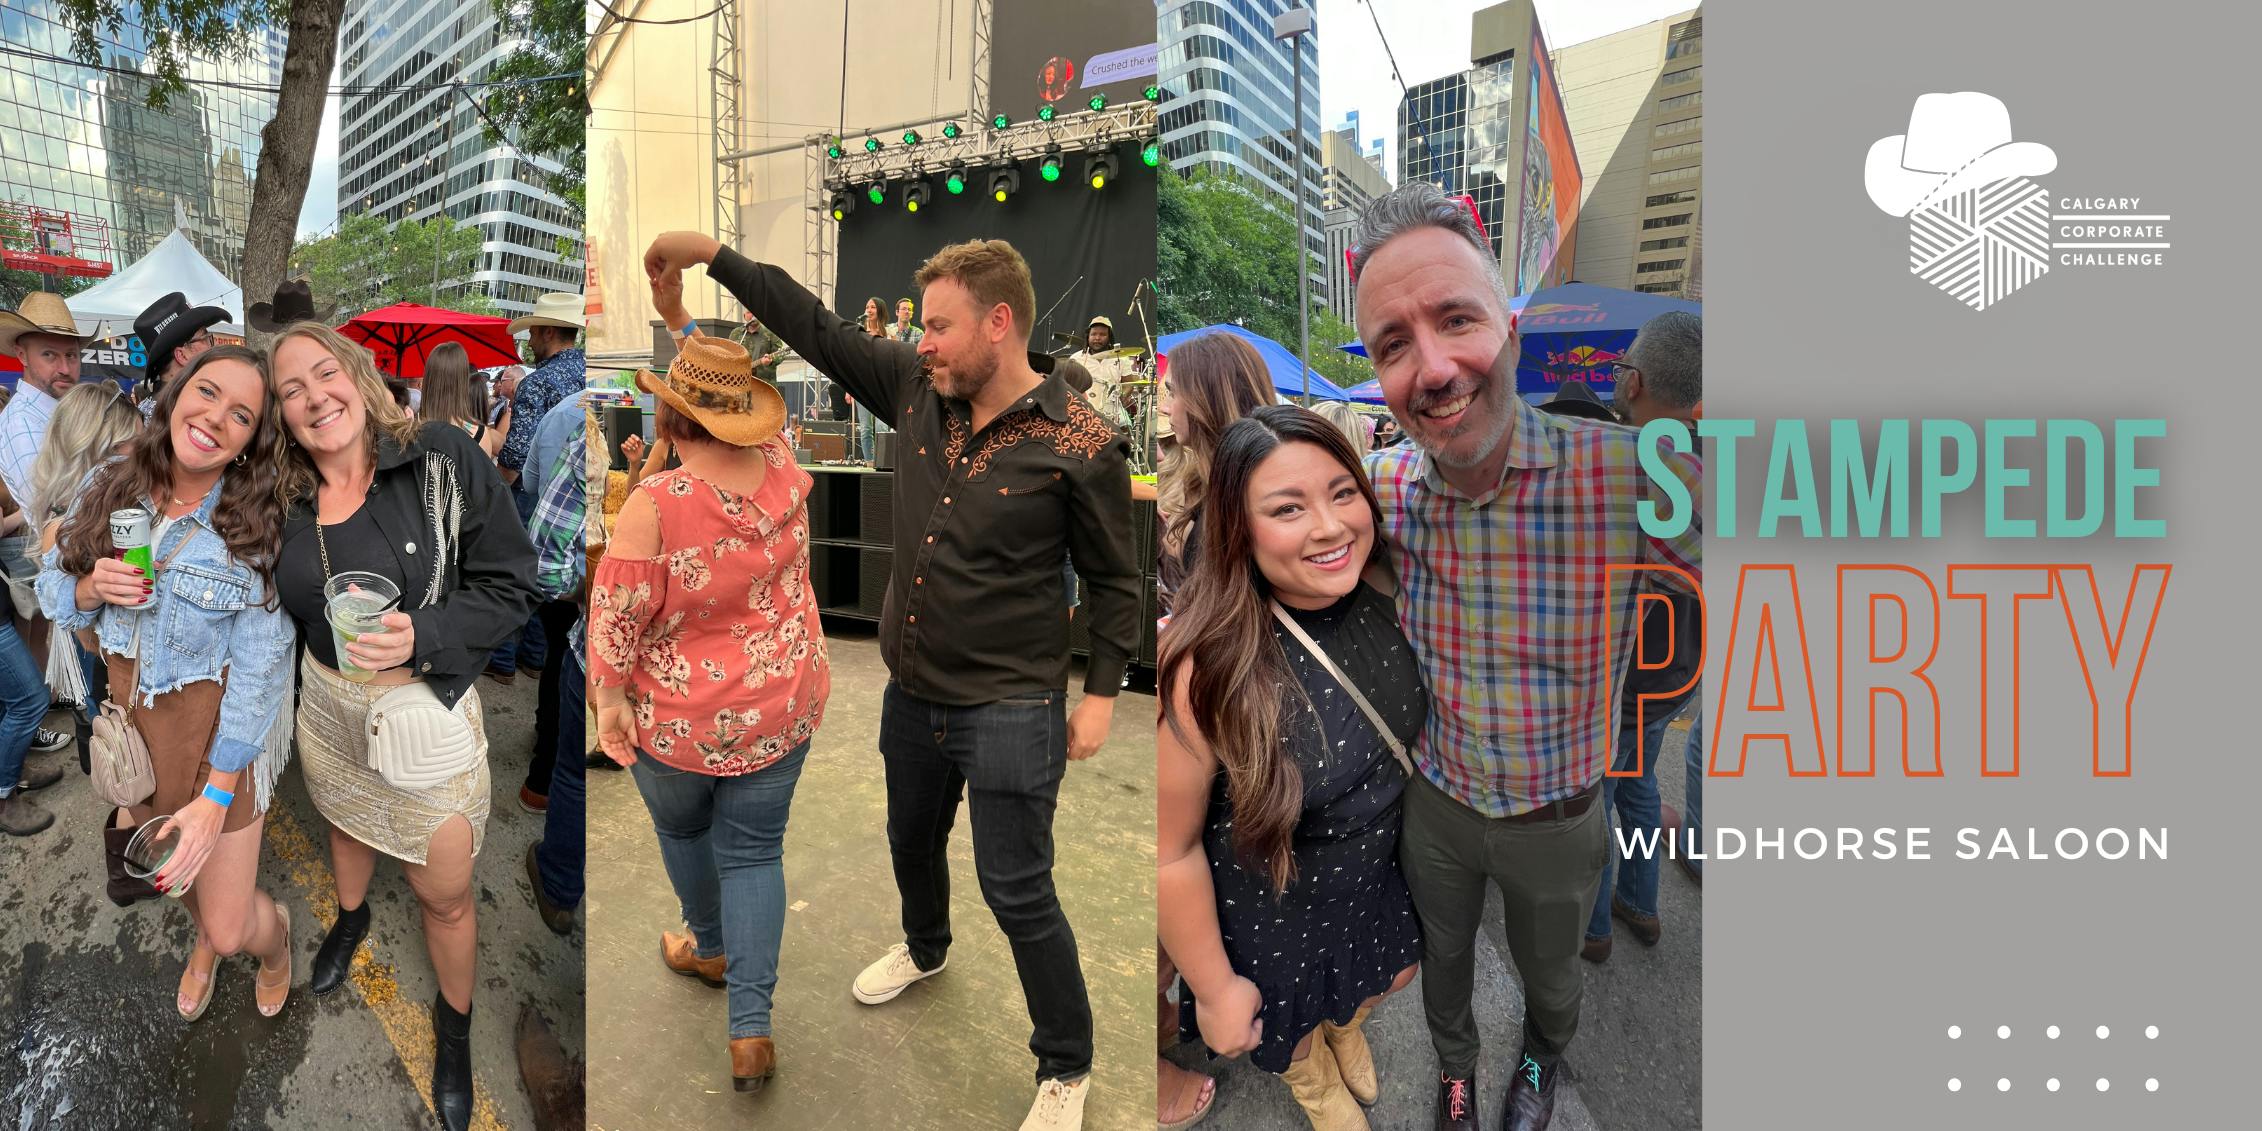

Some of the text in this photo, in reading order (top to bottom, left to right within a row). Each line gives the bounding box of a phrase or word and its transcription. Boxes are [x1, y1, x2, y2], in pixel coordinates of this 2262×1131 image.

[1091, 61, 1128, 75] Crushed
[1130, 57, 1145, 67] the
[81, 348, 147, 367] ZERO
